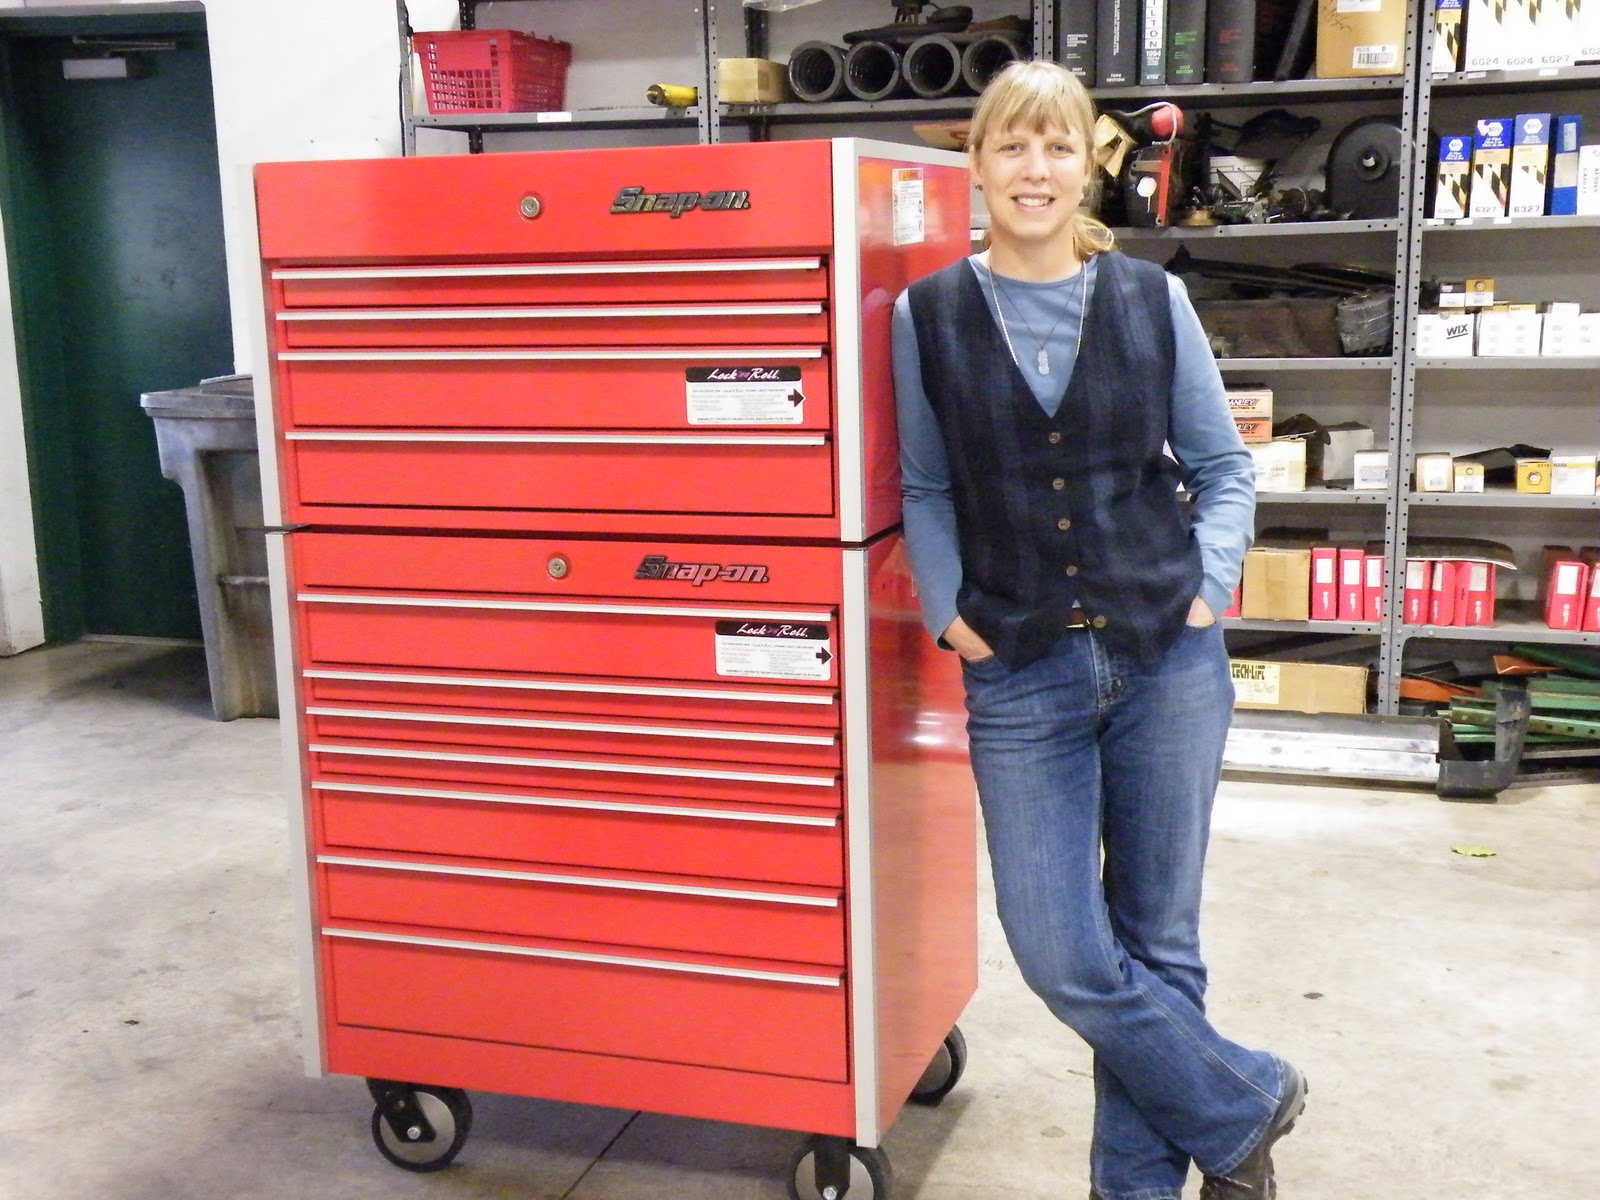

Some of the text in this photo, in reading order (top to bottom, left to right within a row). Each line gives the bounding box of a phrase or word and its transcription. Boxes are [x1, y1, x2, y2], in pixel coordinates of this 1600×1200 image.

[1581, 48, 1600, 56] 602
[1471, 57, 1499, 66] 6024
[1506, 57, 1534, 66] 6024
[1541, 55, 1570, 64] 6027
[1514, 205, 1540, 213] 6327
[1446, 323, 1468, 336] WIX
[707, 368, 738, 380] Lock
[1228, 398, 1257, 406] ANLEY
[736, 623, 767, 635] Lock
